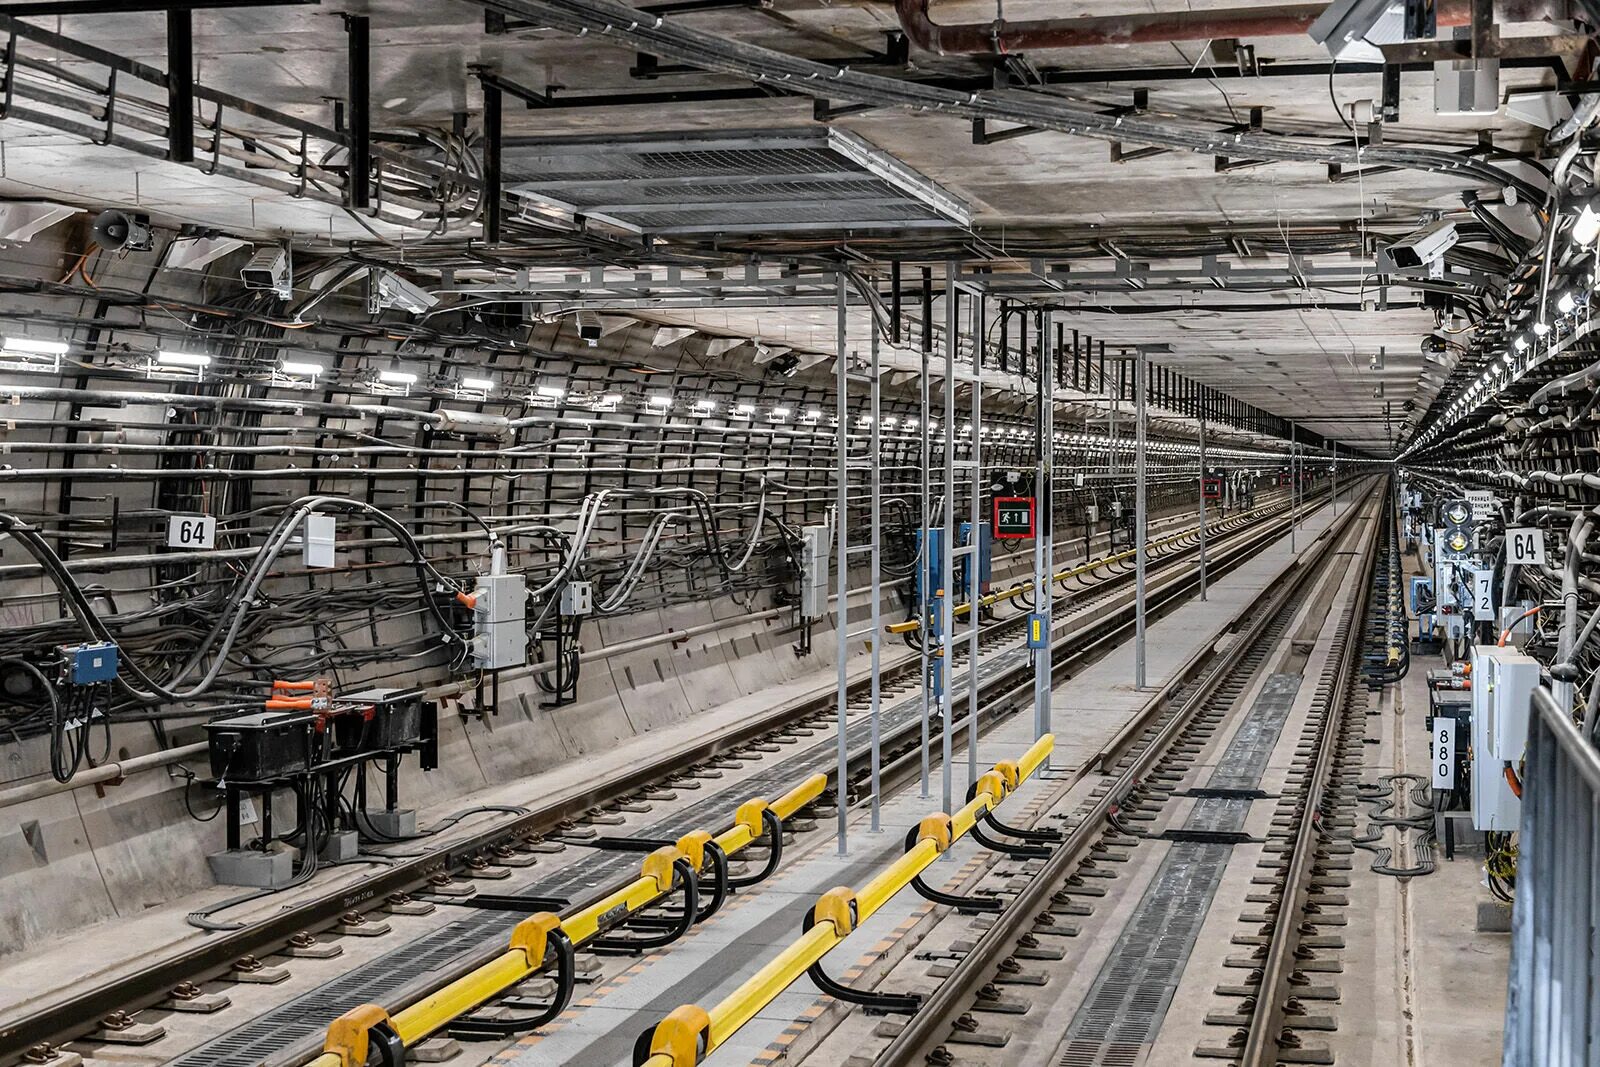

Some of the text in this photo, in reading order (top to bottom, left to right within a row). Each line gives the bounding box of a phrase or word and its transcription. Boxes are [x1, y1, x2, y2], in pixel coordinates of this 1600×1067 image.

[180, 520, 206, 545] 64
[1514, 533, 1537, 560] 64
[1480, 579, 1490, 610] 72
[1438, 729, 1449, 777] 880
